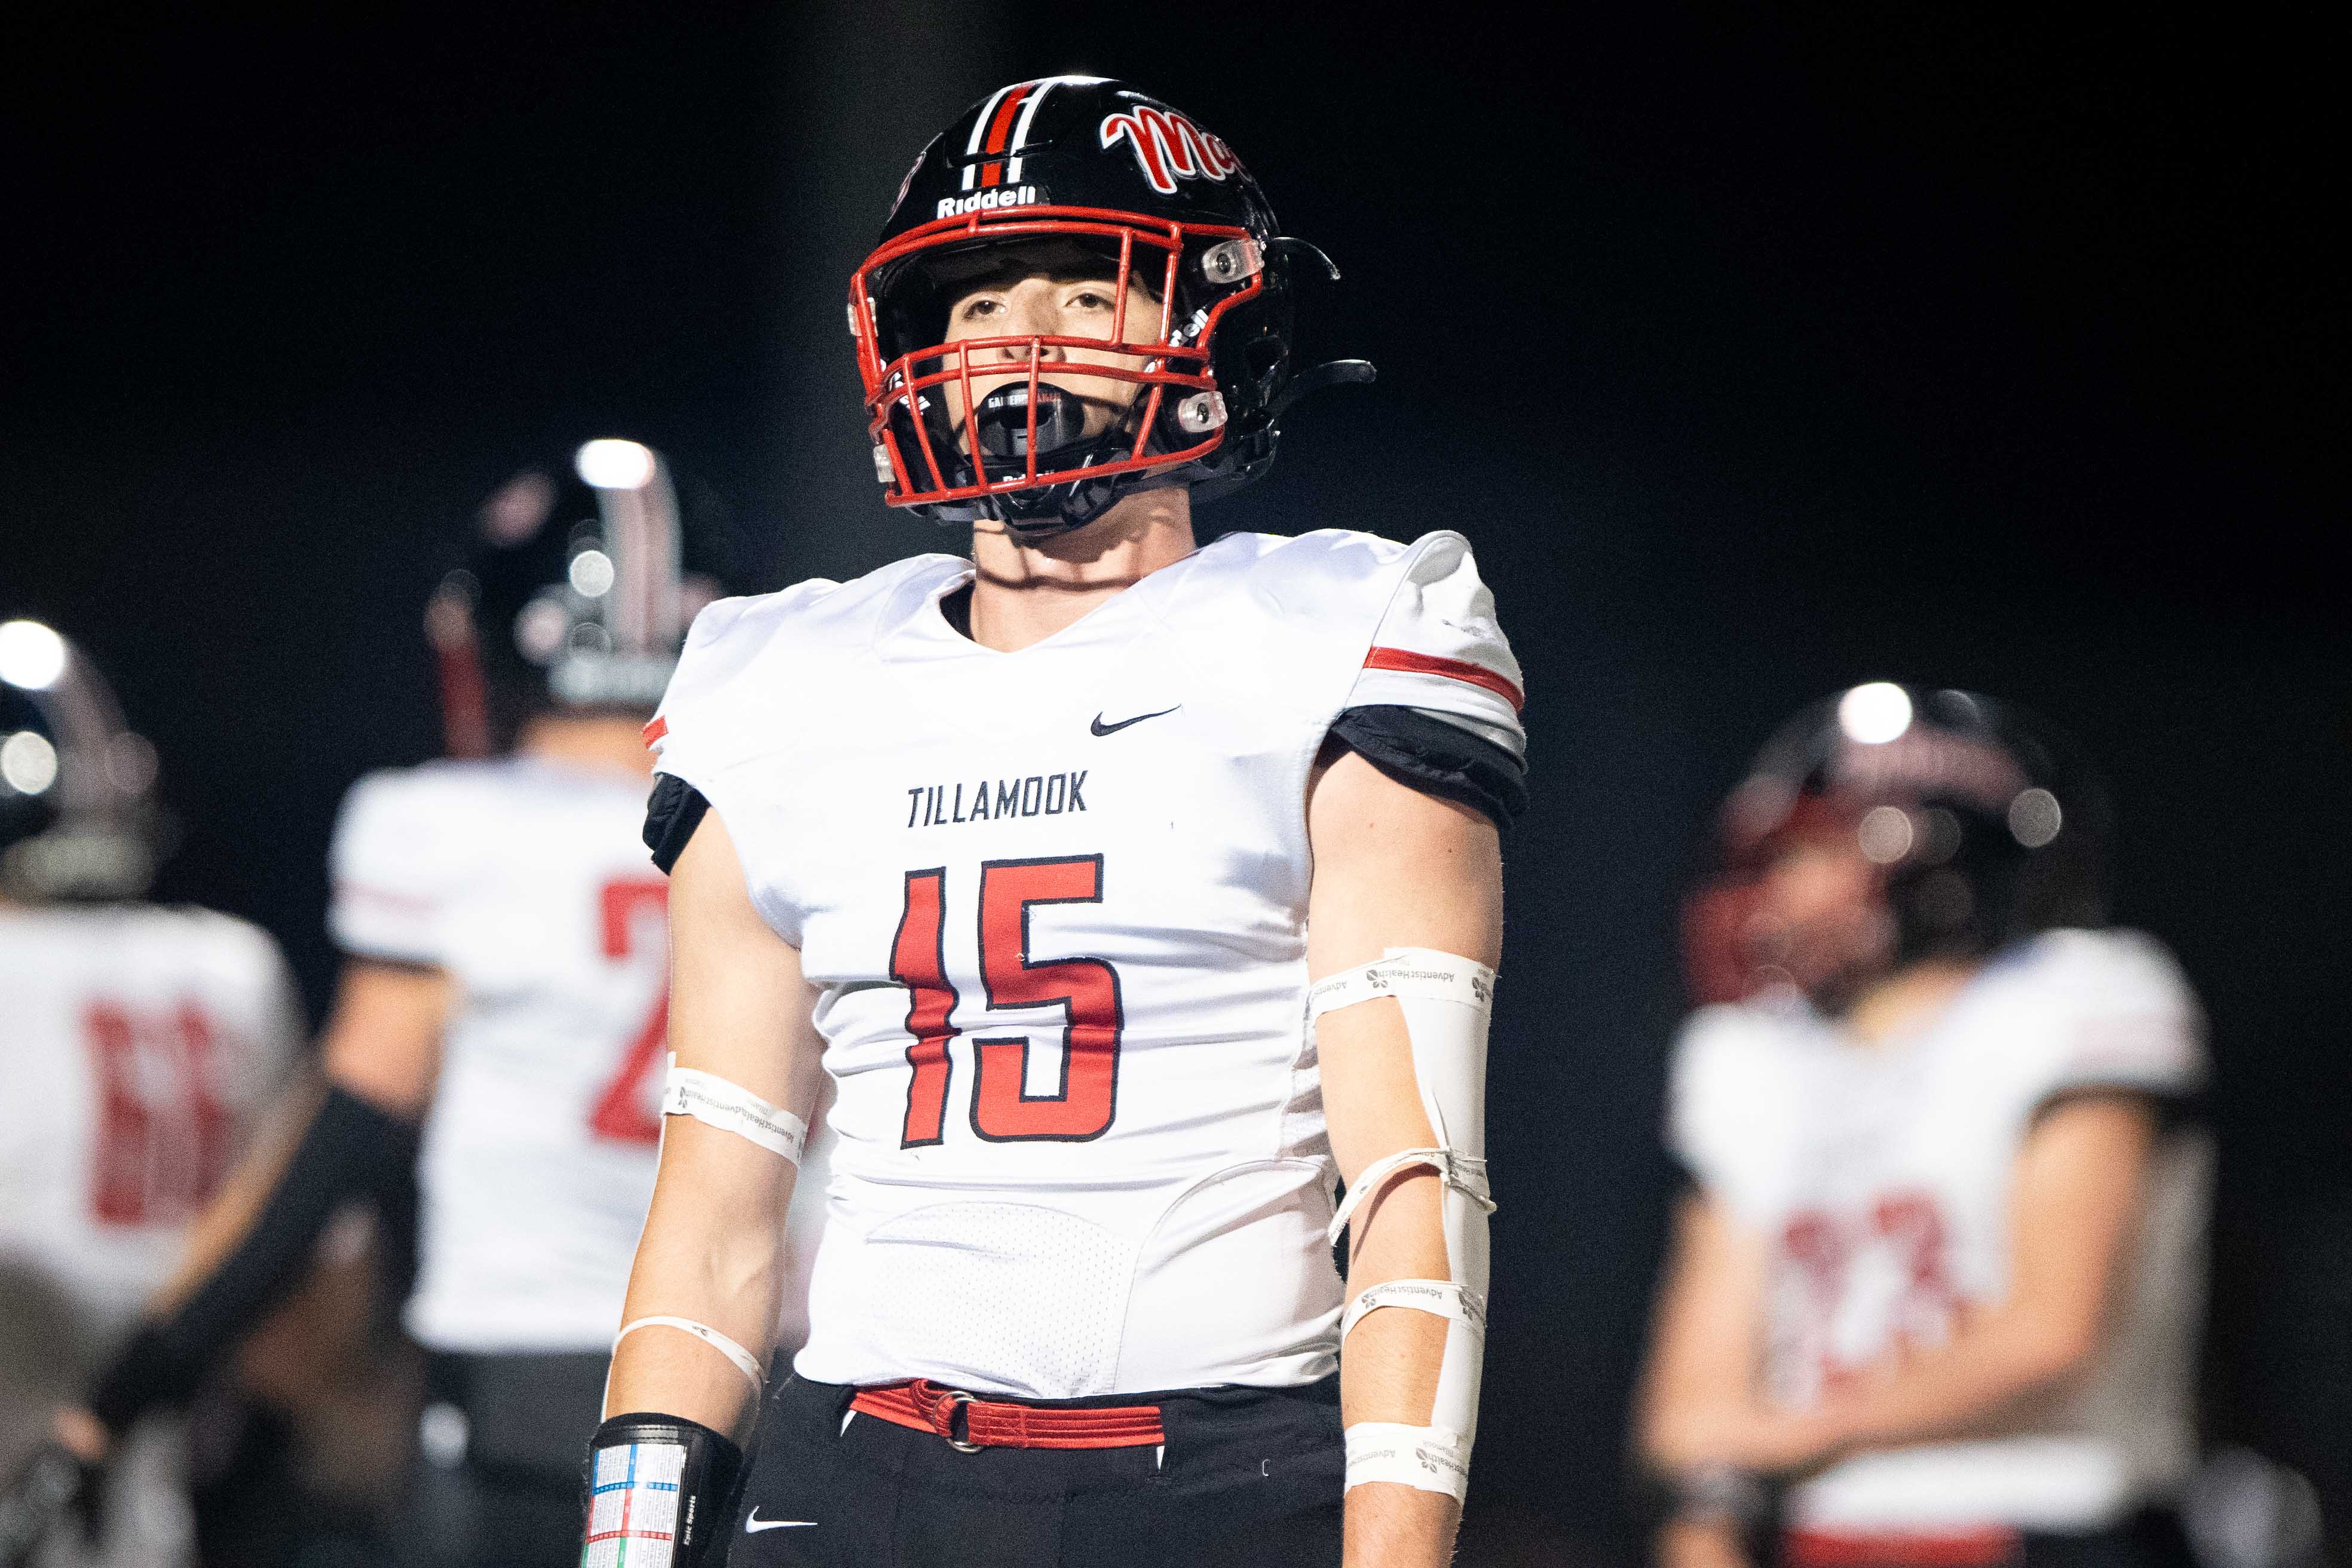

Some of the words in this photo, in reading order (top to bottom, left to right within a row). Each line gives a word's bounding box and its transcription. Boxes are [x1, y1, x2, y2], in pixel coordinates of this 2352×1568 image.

[937, 186, 1036, 220] Riddell
[908, 770, 1088, 828] TILLAMOOK
[889, 853, 1125, 1151] 15
